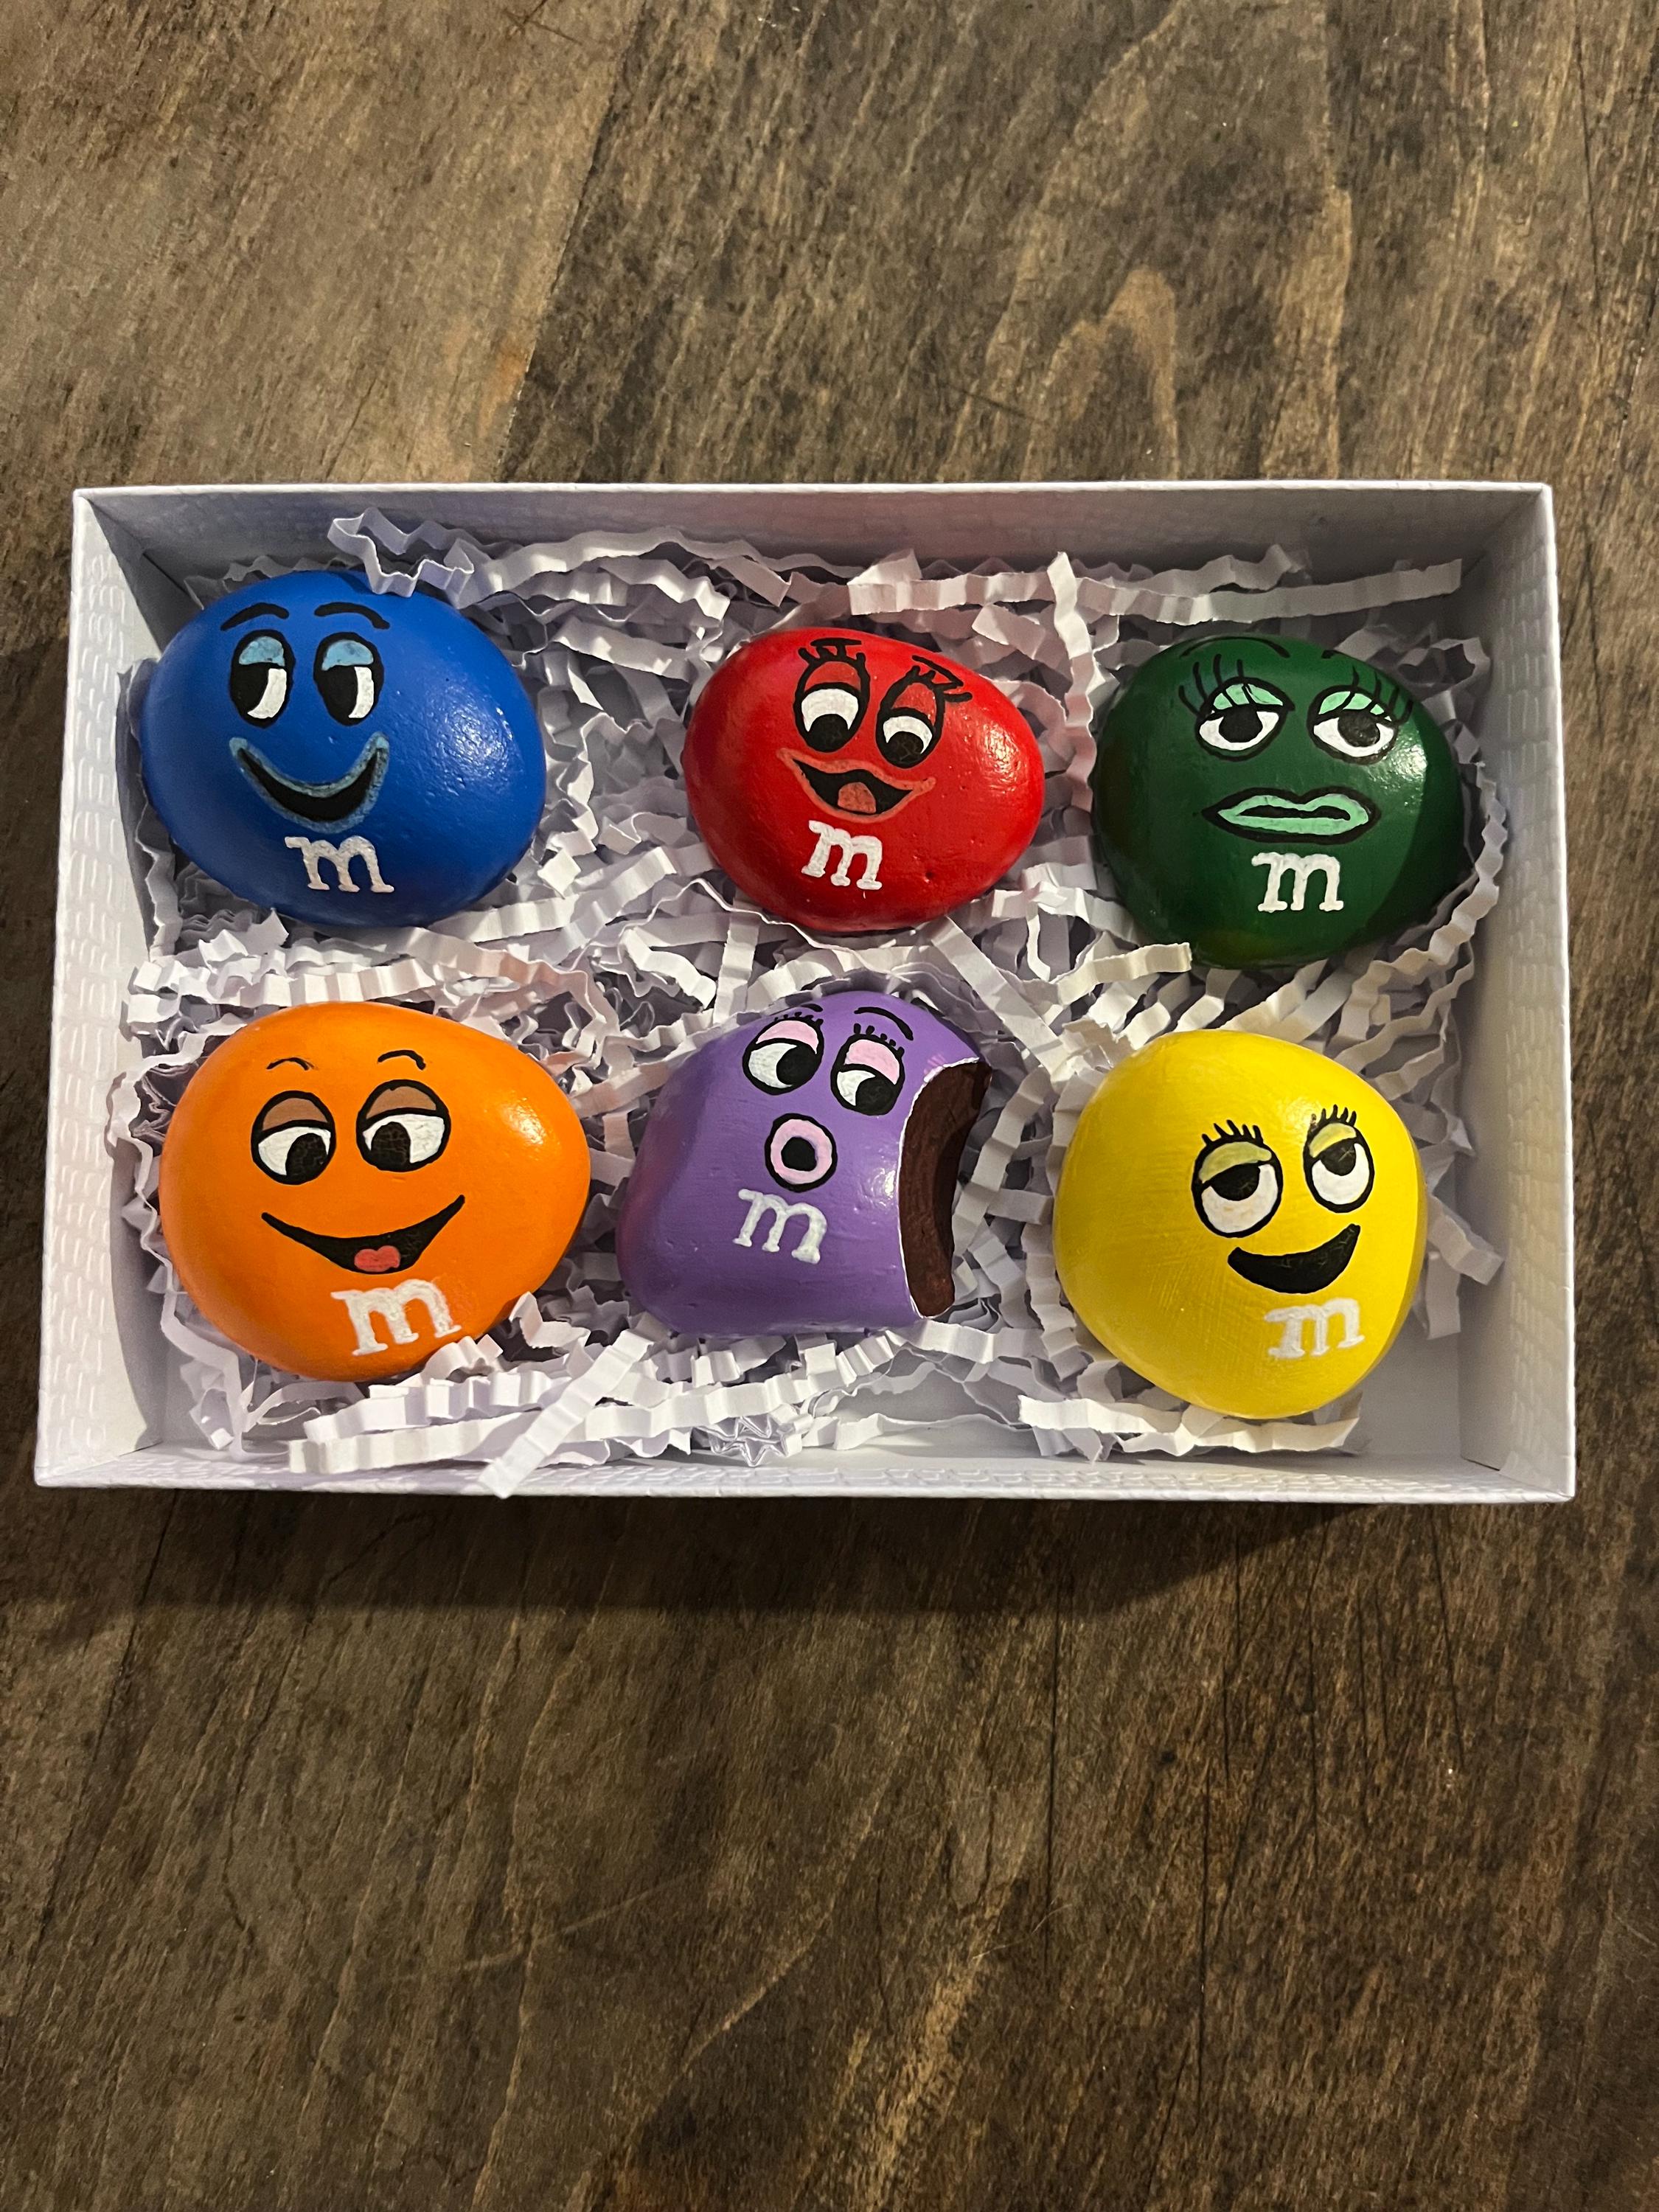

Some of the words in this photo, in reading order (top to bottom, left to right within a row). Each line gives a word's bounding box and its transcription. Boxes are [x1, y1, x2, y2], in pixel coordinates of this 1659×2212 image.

[284, 835, 394, 893] m
[801, 820, 884, 891] m
[1251, 852, 1344, 914] m
[733, 1188, 827, 1264] m
[330, 1279, 462, 1356] m
[1265, 1297, 1366, 1359] m
